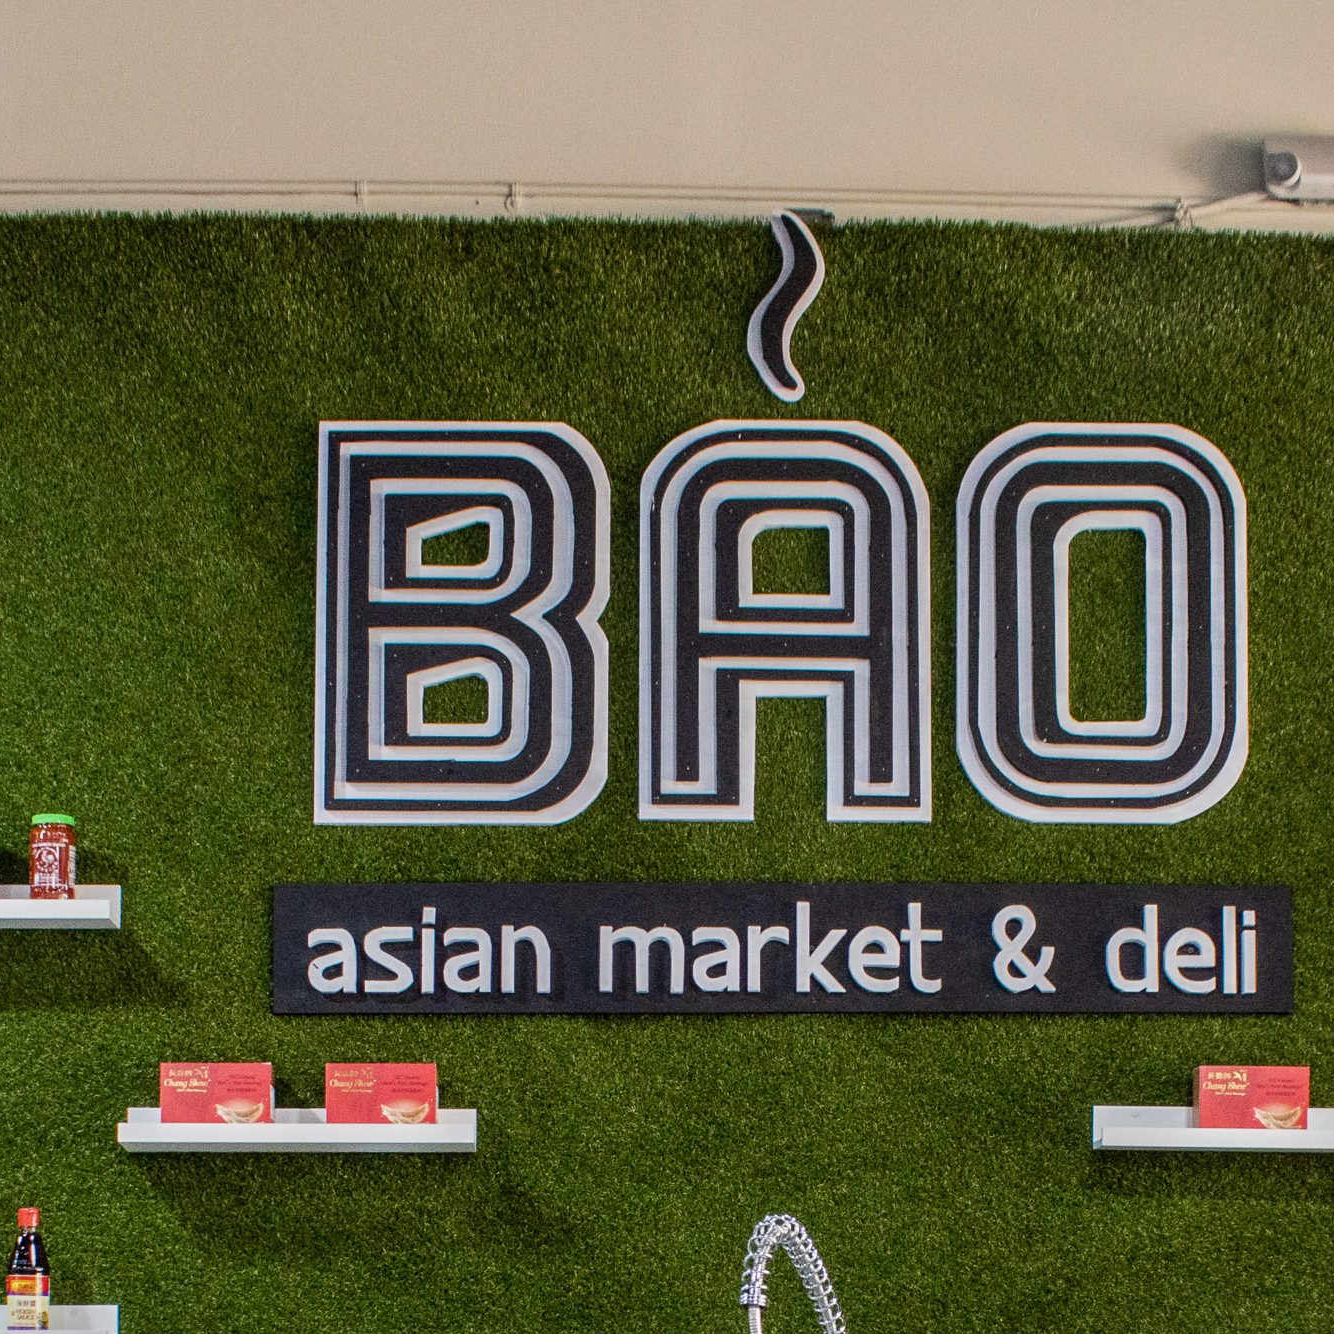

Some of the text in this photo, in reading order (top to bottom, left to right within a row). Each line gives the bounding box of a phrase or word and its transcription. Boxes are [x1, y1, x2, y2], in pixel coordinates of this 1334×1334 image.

[307, 900, 1259, 996] asian market & deli
